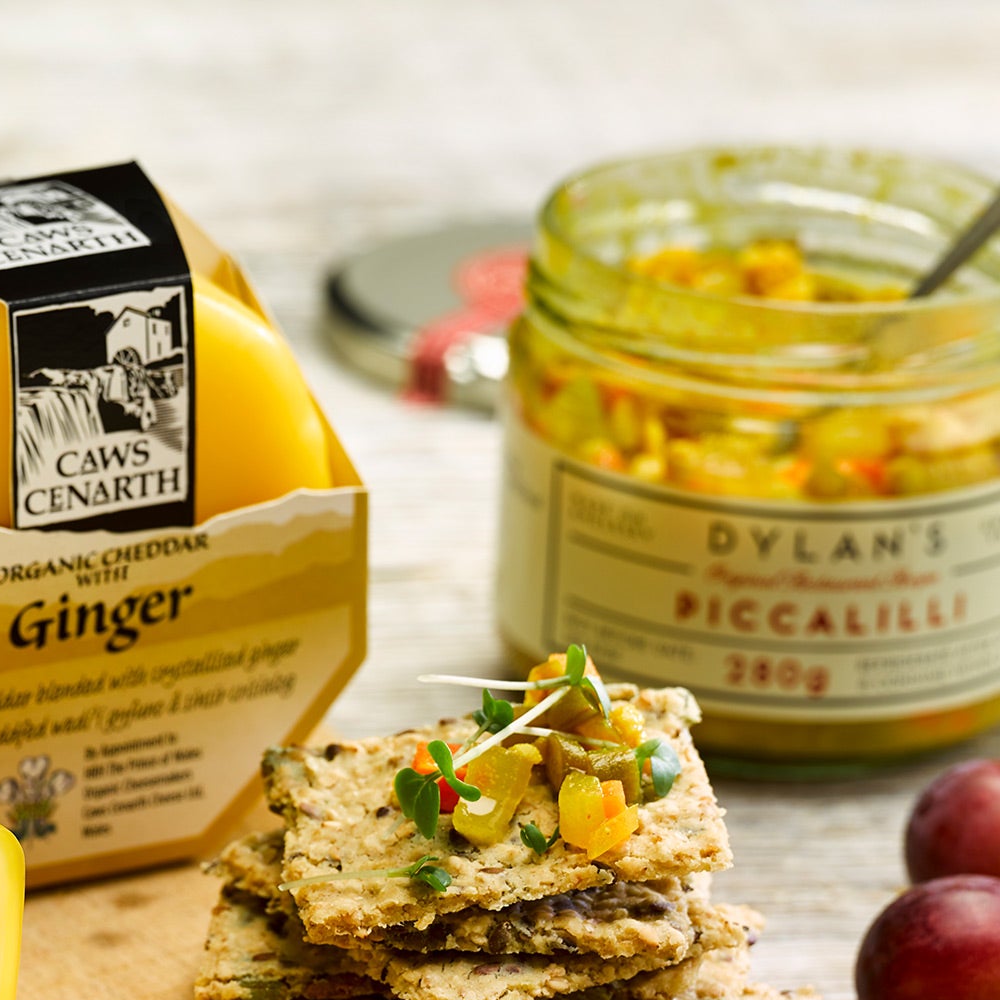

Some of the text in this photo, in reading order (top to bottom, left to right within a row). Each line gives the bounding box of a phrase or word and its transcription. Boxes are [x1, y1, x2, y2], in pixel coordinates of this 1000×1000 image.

[56, 439, 150, 479] CAWS
[24, 467, 181, 516] CENARTH
[100, 533, 210, 571] CHEDDAR
[706, 519, 949, 564] DYLAN'S
[76, 564, 130, 588] WITH
[8, 583, 195, 654] Ginger
[673, 589, 968, 638] PICCALILLI
[723, 653, 831, 699] 280g
